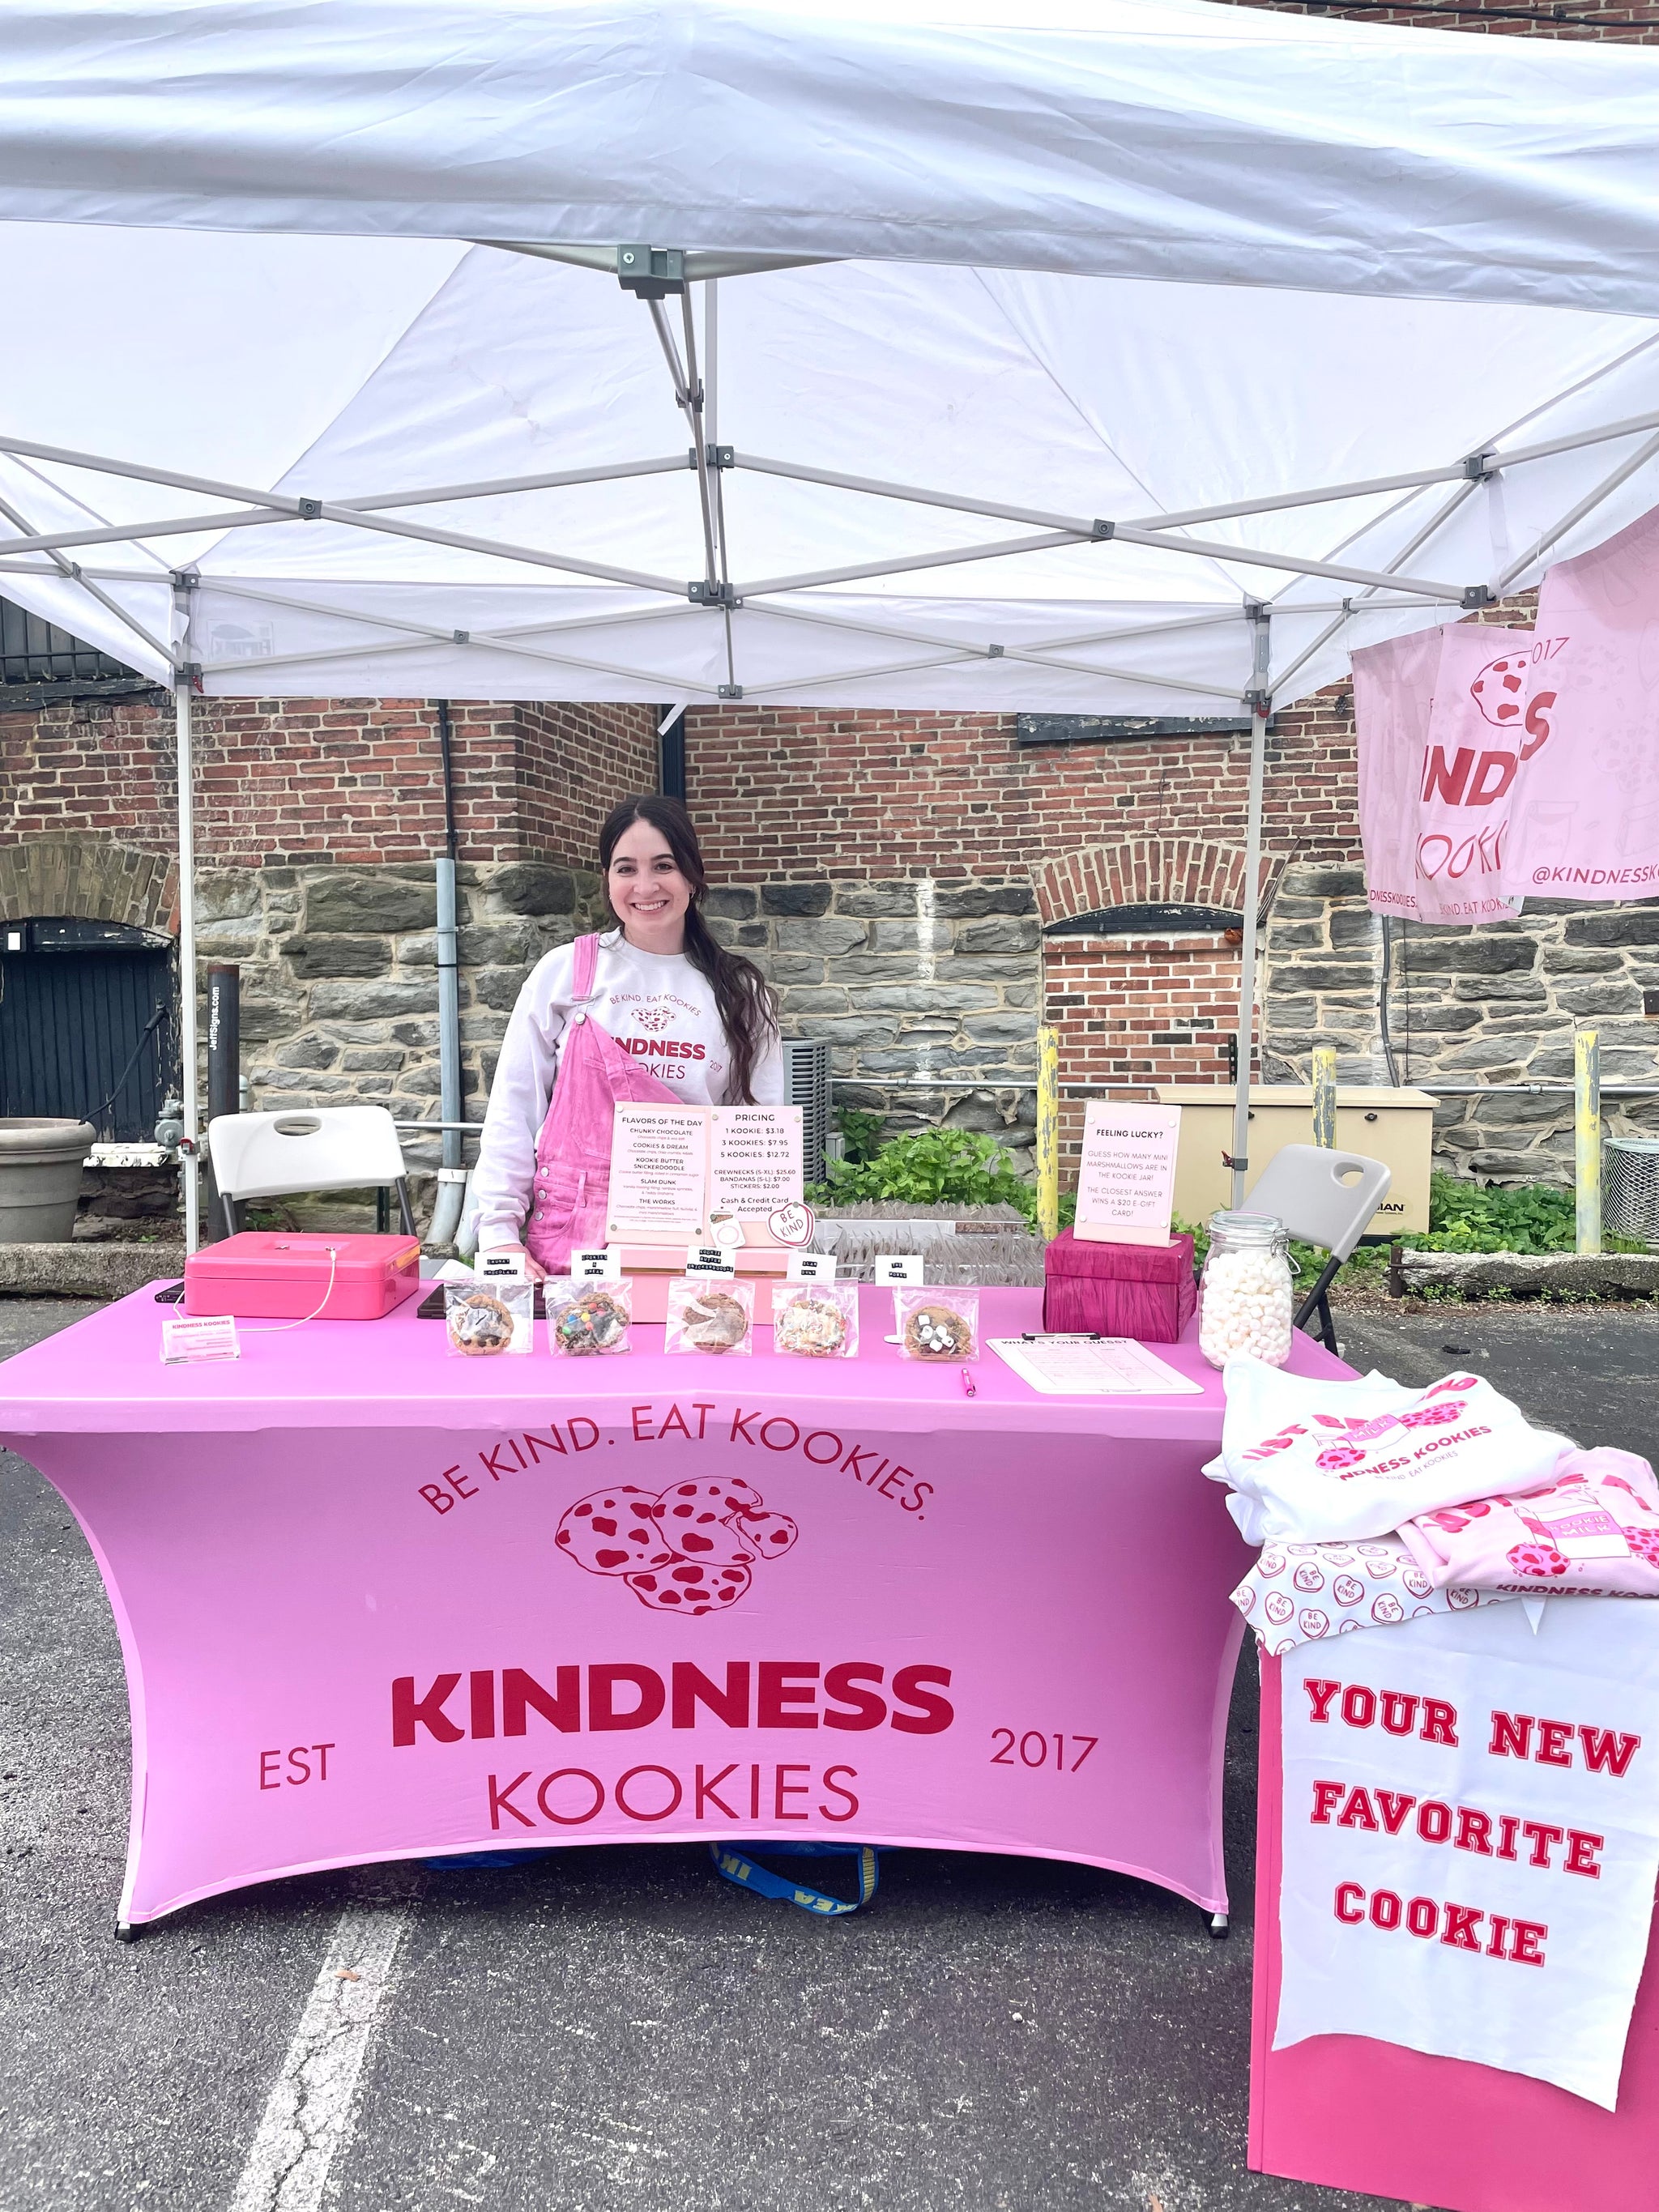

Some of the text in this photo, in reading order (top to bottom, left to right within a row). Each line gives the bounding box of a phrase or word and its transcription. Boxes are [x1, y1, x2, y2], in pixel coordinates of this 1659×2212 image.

[1531, 637, 1570, 664] 017
[1533, 864, 1659, 884] @KINDNESSK
[1464, 901, 1478, 914] EAT
[610, 995, 620, 1004] BE
[646, 995, 662, 1003] EAT
[209, 986, 221, 1051] JeffSigns.com
[622, 1117, 656, 1125] FLAVORS
[735, 1114, 775, 1122] PRICING
[1096, 1129, 1163, 1140] FEELING LUCKY?
[1088, 1150, 1111, 1158] GUESS
[1132, 1153, 1152, 1161] MANY
[1086, 1161, 1144, 1170] MARSHMALLOWS
[1112, 1172, 1137, 1180] KOOKIE
[1101, 1187, 1132, 1196] CLOSEST
[1134, 1190, 1162, 1198] ANSWER
[779, 1209, 795, 1223] BE
[779, 1218, 804, 1238] KIND
[1413, 1426, 1492, 1460] KOOKIES
[418, 1403, 935, 1522] BE KIND. EAT KOOKIES.
[1549, 1515, 1610, 1532] KOOKIE
[1561, 1524, 1611, 1537] MILK
[1299, 1569, 1314, 1587] KIND
[1310, 1570, 1320, 1580] BE
[1346, 1580, 1357, 1591] BE
[1409, 1579, 1428, 1588] KIND
[1496, 1584, 1603, 1596] KINDNESS
[1337, 1585, 1355, 1599] KIND
[1450, 1590, 1469, 1605] KIND
[1276, 1597, 1287, 1608] BE
[1388, 1602, 1399, 1613] BE
[1269, 1604, 1286, 1617] KIND
[1307, 1612, 1318, 1620] BE
[1378, 1601, 1392, 1619] KIND
[1303, 1621, 1321, 1630] KIND
[391, 1661, 955, 1747] KINDNESS
[1303, 1678, 1641, 1778] YOUR NEW
[991, 1728, 1098, 1773] 2017
[260, 1742, 335, 1791] EST
[488, 1763, 859, 1831] KOOKIES
[1310, 1779, 1605, 1879] FAVORITE
[1334, 1881, 1548, 1967] COOKIE
